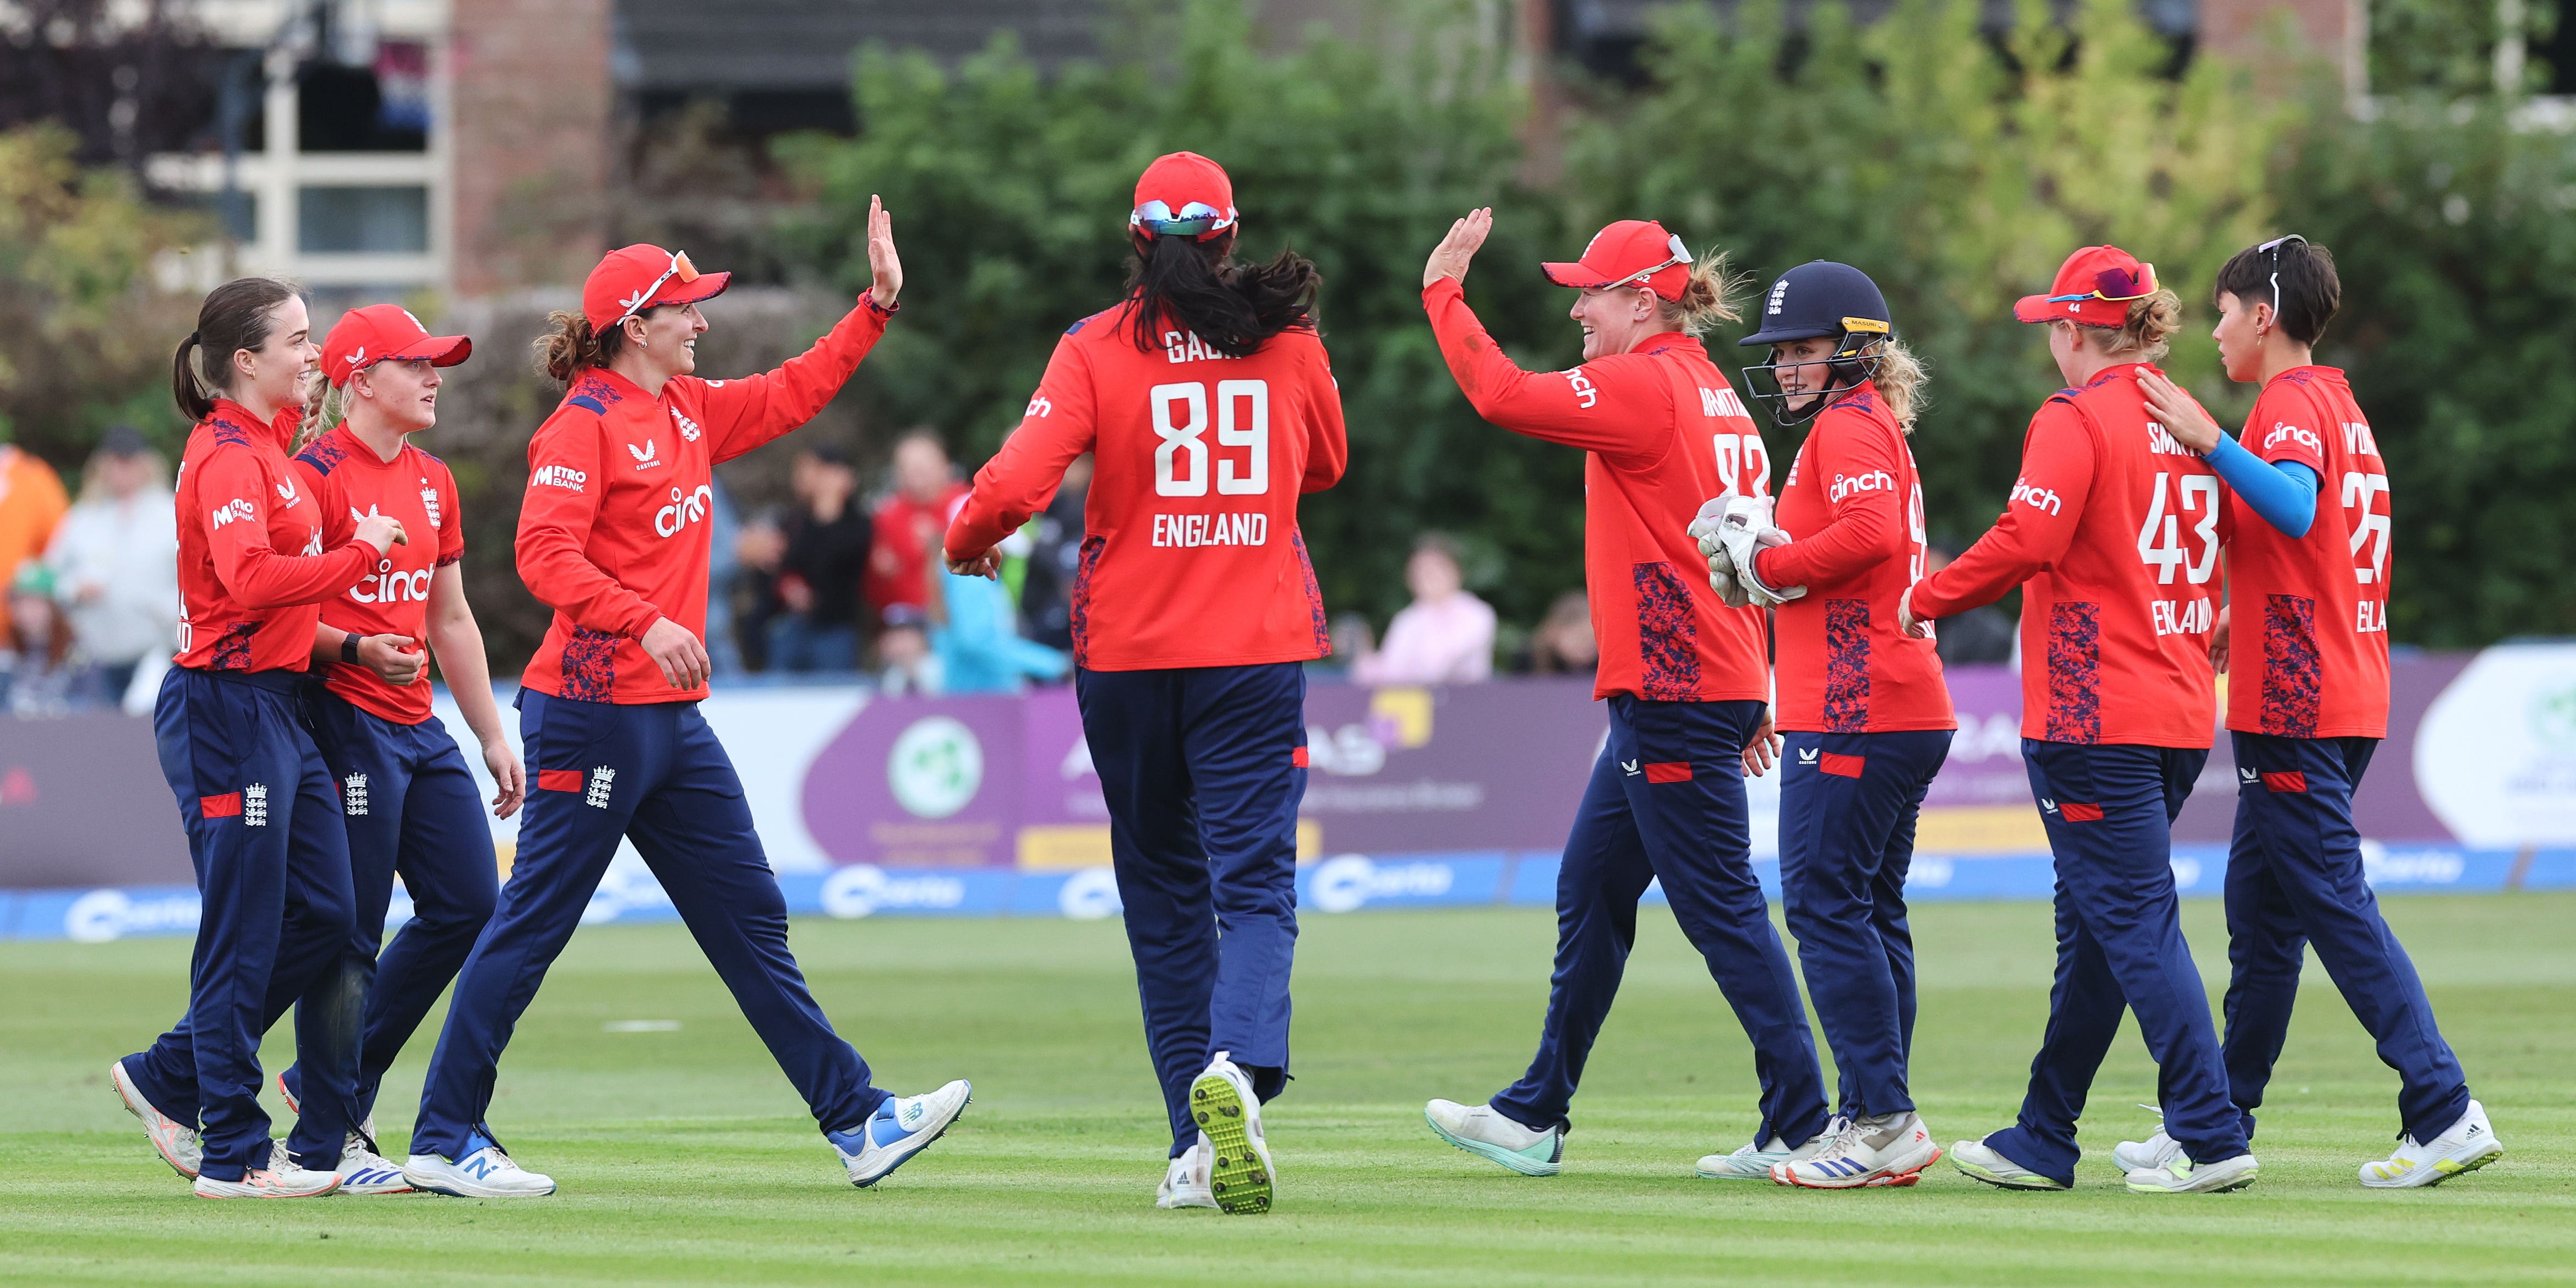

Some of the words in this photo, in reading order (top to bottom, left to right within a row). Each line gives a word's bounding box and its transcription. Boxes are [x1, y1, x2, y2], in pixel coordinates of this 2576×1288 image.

[2068, 303, 2080, 313] 44
[1150, 379, 1269, 498] 89
[2264, 422, 2322, 457] cinch
[532, 465, 587, 487] METRO
[553, 477, 584, 493] BANK
[1830, 470, 1892, 504] cinch
[2009, 477, 2061, 516] inch
[233, 510, 255, 522] BANK
[1152, 513, 1267, 547] ENGLAND
[2137, 472, 2219, 584] 43
